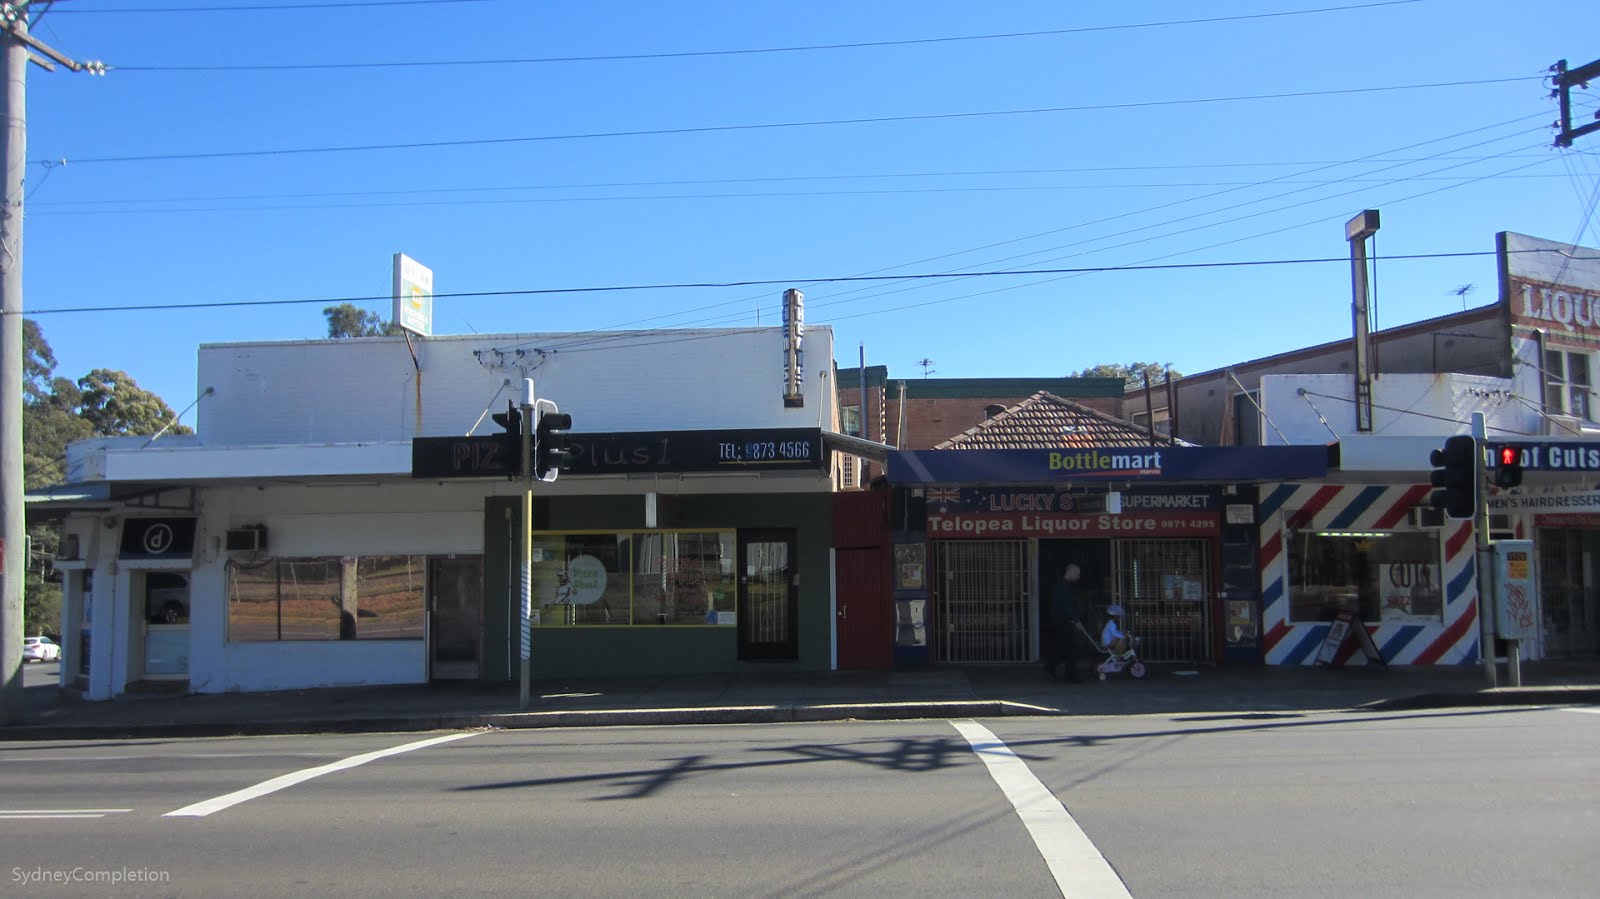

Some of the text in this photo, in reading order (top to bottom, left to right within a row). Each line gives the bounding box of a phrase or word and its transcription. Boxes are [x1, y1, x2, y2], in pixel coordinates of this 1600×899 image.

[745, 443, 775, 459] 9873
[779, 441, 810, 458] 4566
[1520, 446, 1540, 468] of
[1548, 446, 1600, 468] Cuts
[1048, 451, 1162, 470] Bottlemart
[989, 493, 1056, 511] LUCKY
[1120, 494, 1210, 508] SUPERMARKET
[928, 515, 1216, 534] Telopea Liquor Store 9871 4295
